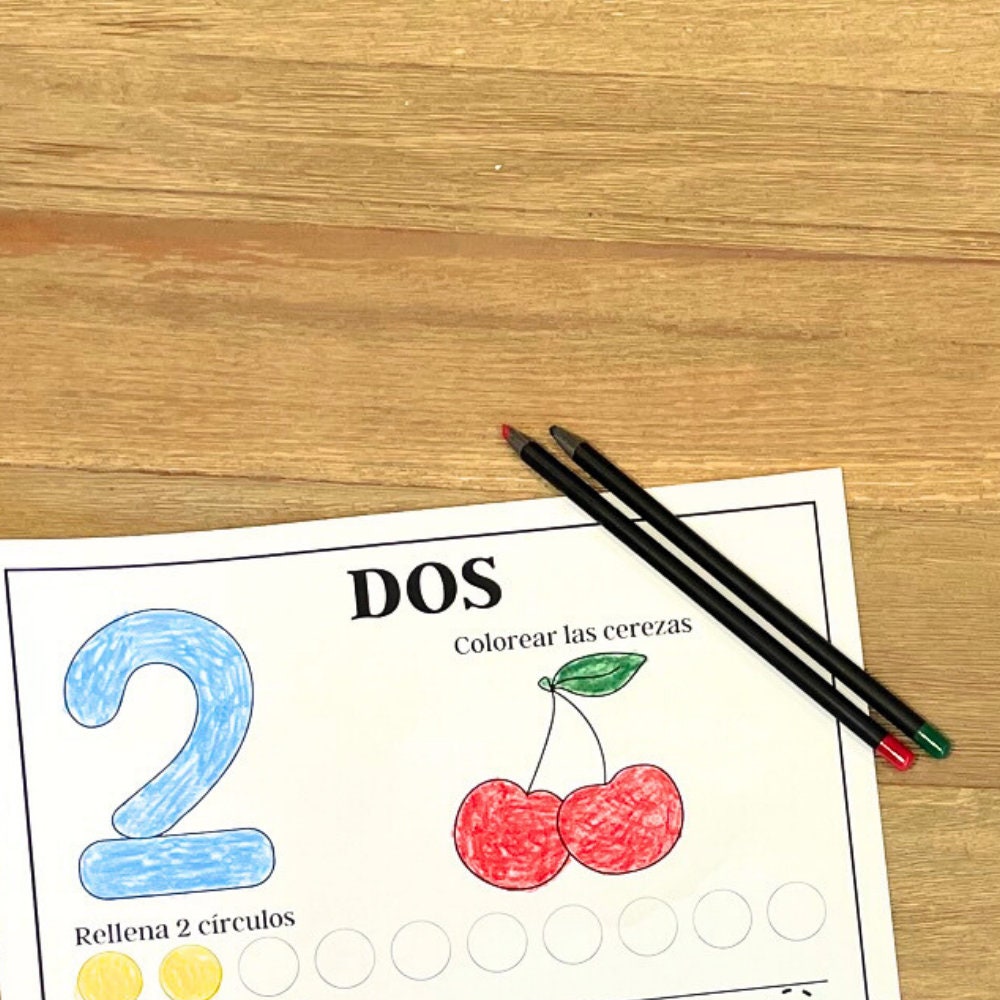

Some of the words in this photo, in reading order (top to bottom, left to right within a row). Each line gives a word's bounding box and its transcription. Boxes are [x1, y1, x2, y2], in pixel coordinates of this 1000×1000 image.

[347, 556, 502, 620] DOS
[454, 628, 558, 655] Colorear
[565, 624, 598, 645] las
[604, 616, 693, 641] cerezas
[64, 608, 276, 900] 2
[75, 923, 170, 946] Rellena
[176, 918, 191, 938] 2
[198, 909, 296, 936] círculos
